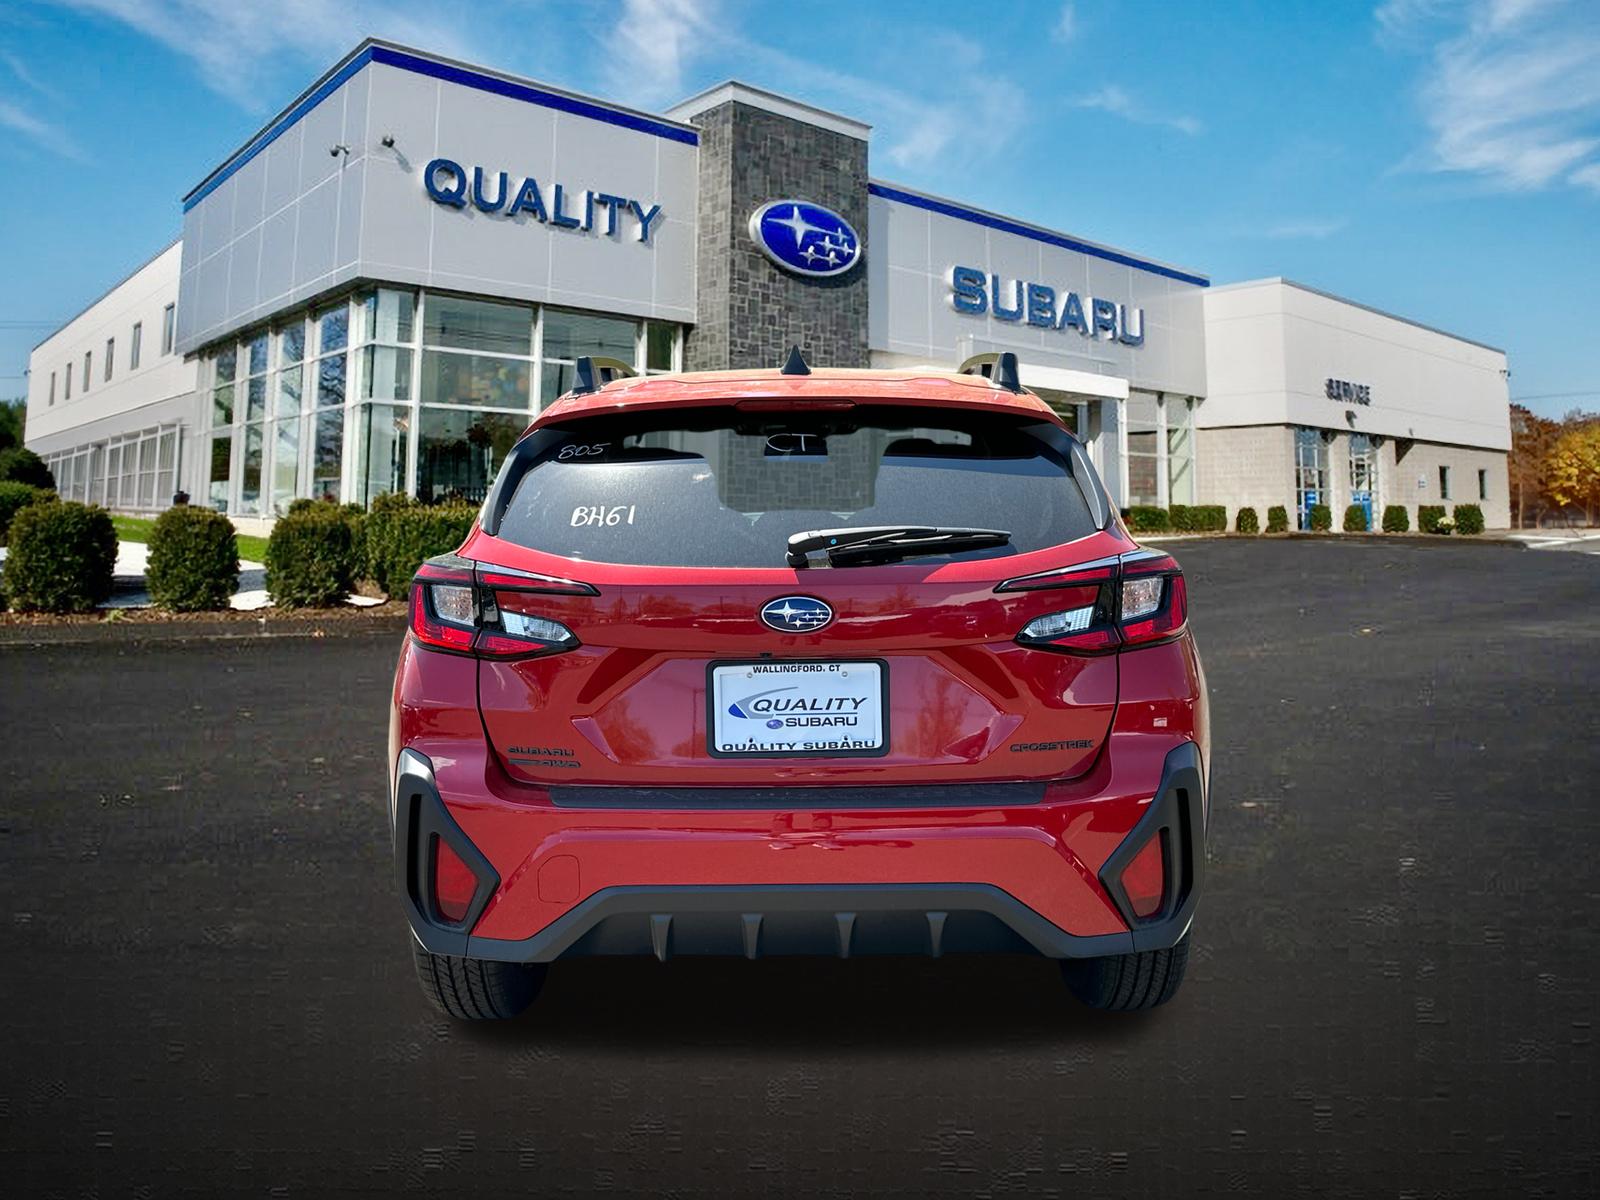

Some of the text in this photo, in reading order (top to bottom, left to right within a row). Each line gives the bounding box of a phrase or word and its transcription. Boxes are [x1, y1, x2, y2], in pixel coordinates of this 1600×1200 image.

[424, 158, 661, 243] QUALITY
[950, 265, 1145, 347] SUBARU
[1326, 378, 1370, 406] SERVICE
[766, 433, 817, 452] CT
[570, 505, 636, 527] BH61
[829, 664, 841, 672] CT
[753, 697, 868, 712] QUALITY
[785, 717, 858, 727] SUBARU
[508, 746, 575, 756] SUBARU
[722, 740, 875, 751] QUALITY SUBARU
[1010, 740, 1094, 752] CROSSTREK
